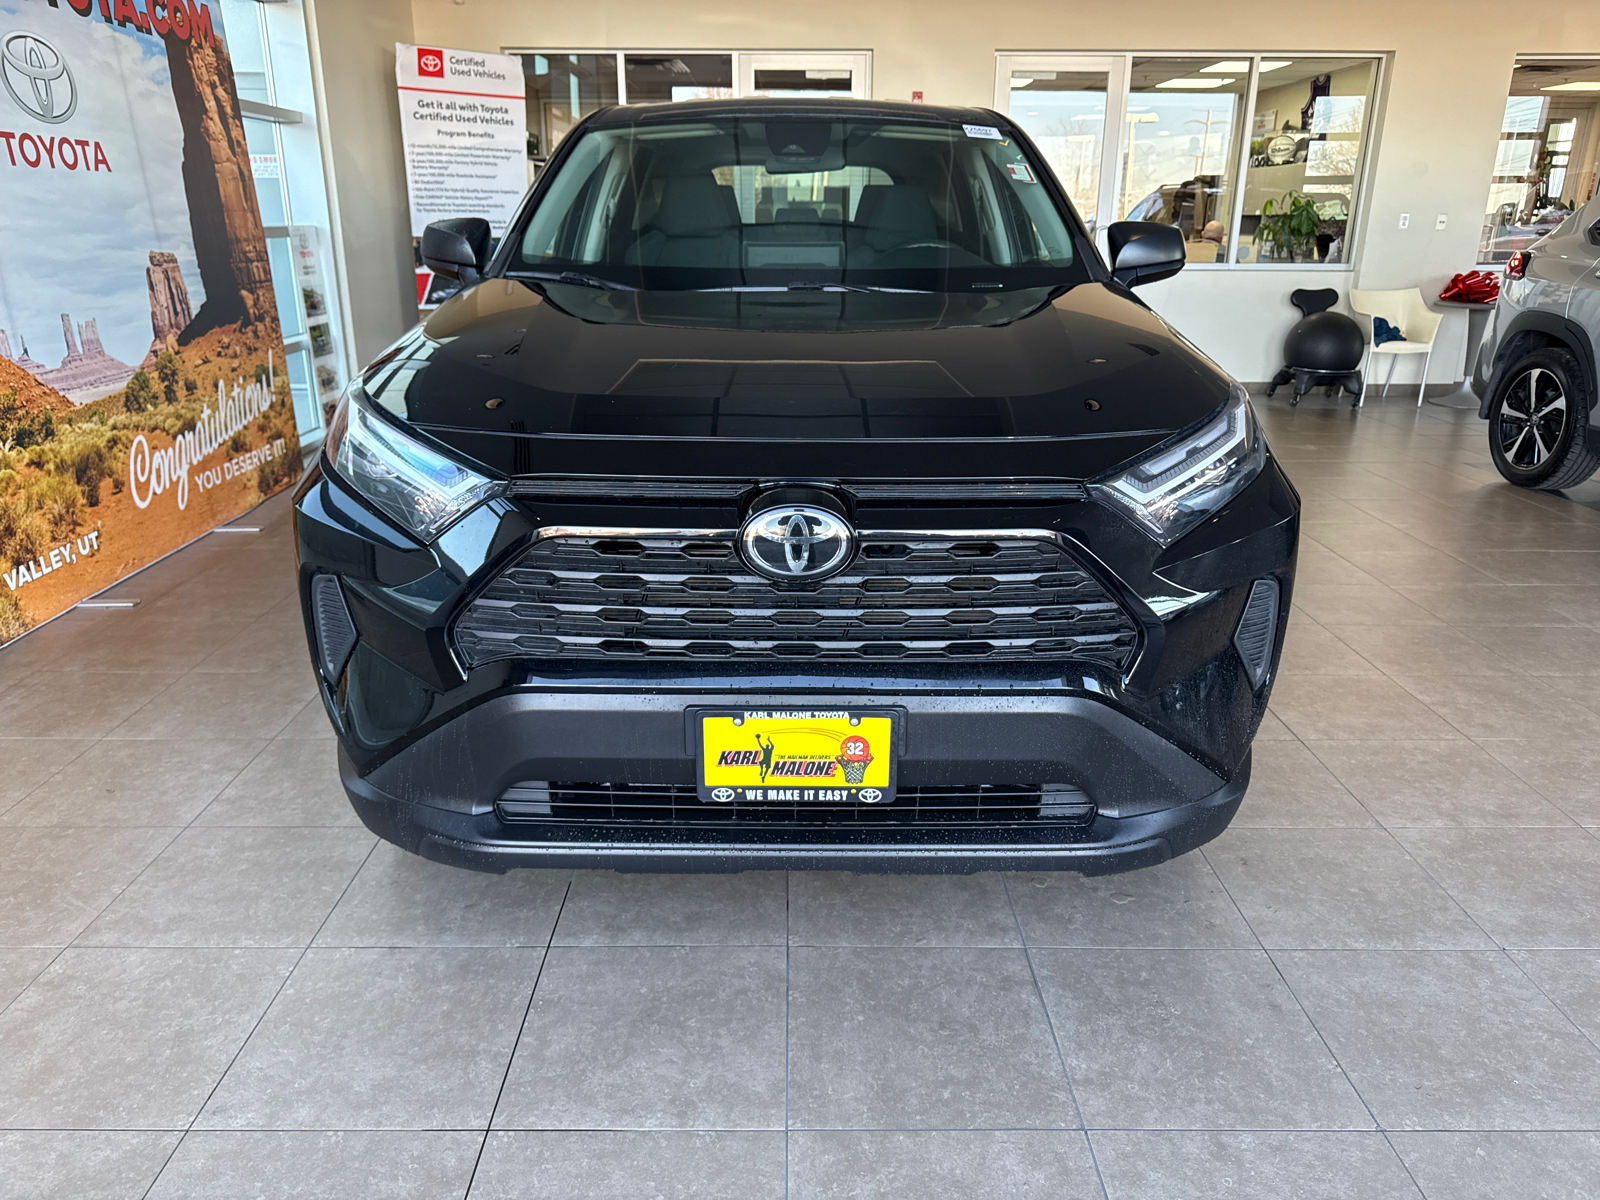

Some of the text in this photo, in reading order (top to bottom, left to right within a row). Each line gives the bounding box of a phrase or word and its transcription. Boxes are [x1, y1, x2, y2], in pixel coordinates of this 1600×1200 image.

[449, 56, 486, 68] Certified
[450, 67, 506, 80] Used Vehicles
[418, 100, 509, 115] Get it all with Toyota
[413, 111, 514, 126] Certified Used Vehicles
[437, 129, 495, 139] Program Benefits
[0, 131, 112, 173] TOYOTA
[129, 348, 277, 510] Congratulations!
[194, 437, 287, 493] YOU DESERVE IT!
[2, 531, 99, 591] VALLEY, UT
[744, 711, 850, 720] KARL MALONE TOYOTA
[846, 742, 864, 755] 32
[717, 750, 762, 766] KARL
[769, 761, 837, 777] MALONE
[745, 789, 848, 801] WE MAKE IT EASY
